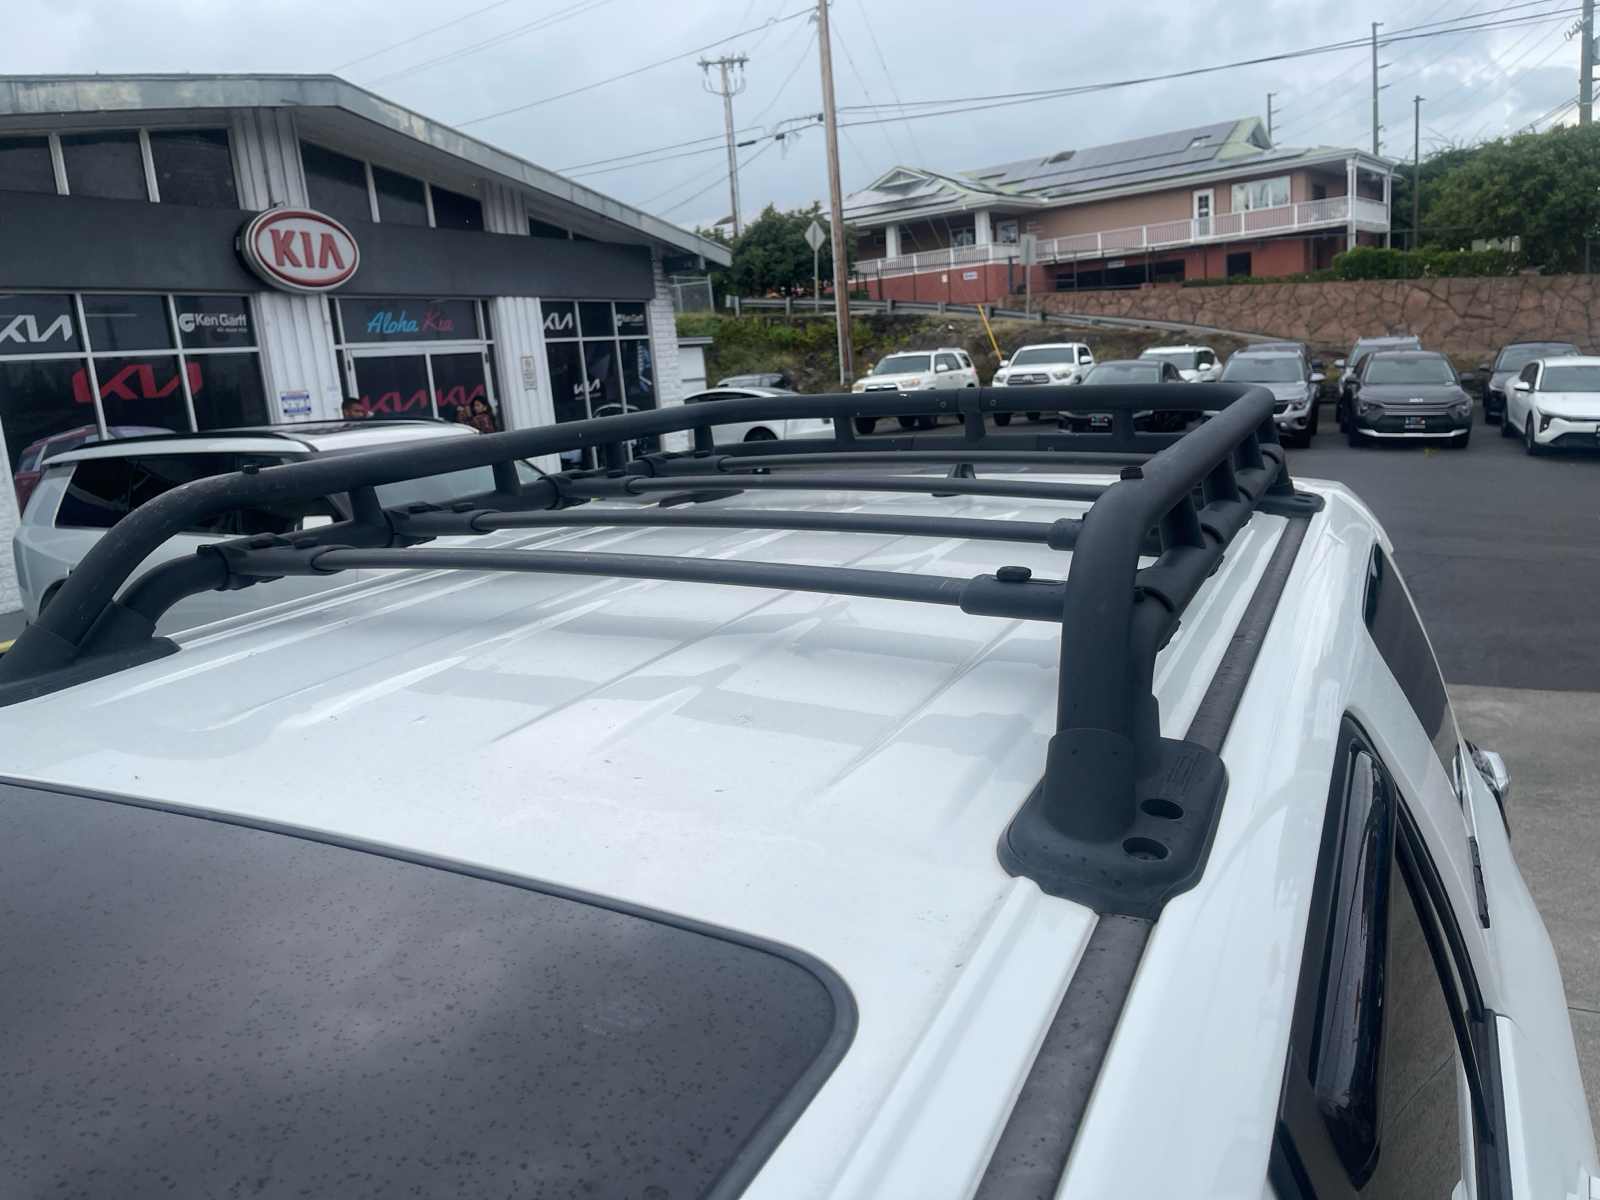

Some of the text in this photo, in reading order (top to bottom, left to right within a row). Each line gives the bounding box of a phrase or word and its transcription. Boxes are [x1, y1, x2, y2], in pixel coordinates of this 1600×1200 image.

[269, 229, 345, 269] KIA
[195, 313, 218, 326] Ken
[366, 310, 454, 334] Aloha Kia
